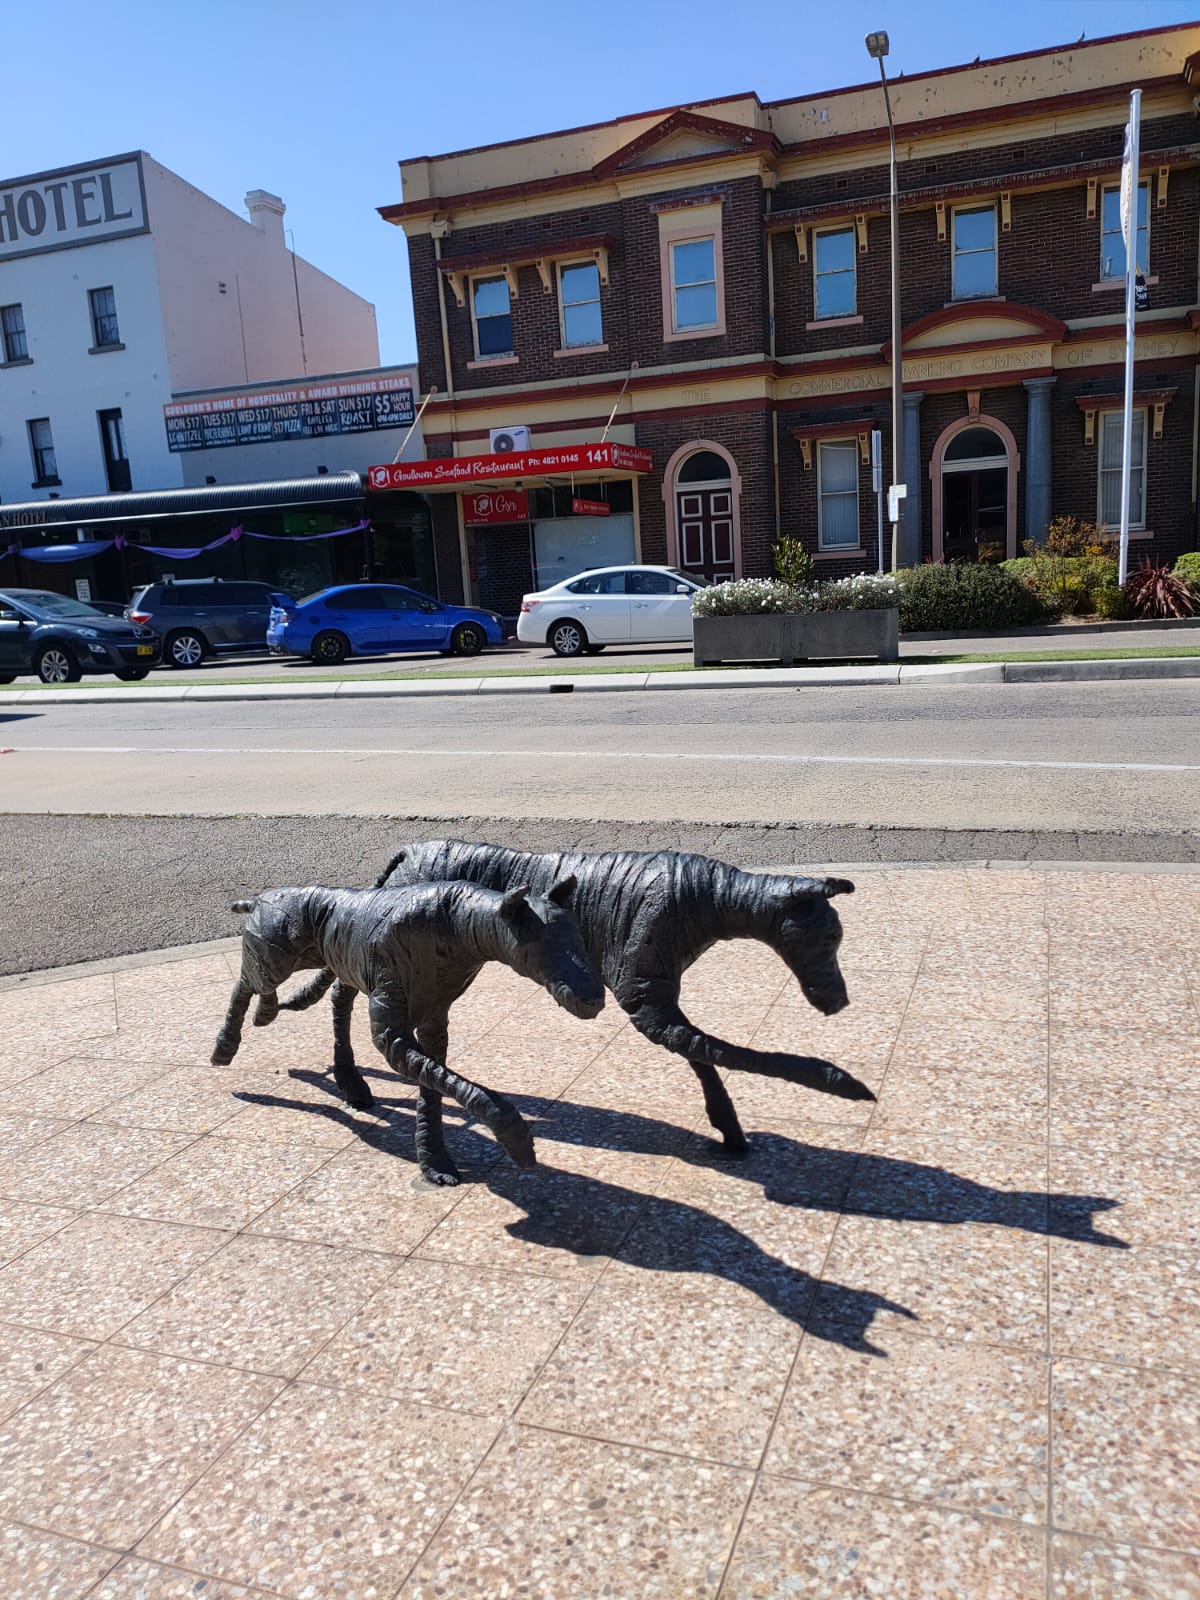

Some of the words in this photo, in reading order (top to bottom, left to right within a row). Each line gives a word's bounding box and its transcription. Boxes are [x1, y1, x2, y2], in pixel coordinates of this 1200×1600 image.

[0, 172, 133, 243] HOTEL
[683, 388, 713, 403] THE
[789, 373, 885, 396] COMMERCIAL
[902, 359, 963, 379] BANKING
[972, 349, 1046, 370] COMPANY
[1067, 349, 1093, 365] OF
[213, 399, 234, 410] HOME
[237, 398, 246, 407] OF
[248, 391, 296, 406] HOSPITALITY
[308, 387, 337, 399] AWARD
[339, 383, 377, 395] WINNING
[379, 377, 410, 390] STEAKS
[390, 391, 411, 402] HAPPY
[272, 404, 298, 418] THURS
[301, 403, 313, 416] FRI
[314, 404, 321, 415] &
[321, 401, 336, 414] SAT
[338, 398, 355, 412] SUN
[356, 395, 372, 409] $17
[375, 394, 391, 414] $5
[393, 401, 412, 412] HOUR
[203, 414, 221, 427] TUES
[222, 412, 236, 426] $17
[237, 410, 255, 423] WED
[256, 408, 270, 421] $17
[341, 410, 372, 425] ROAST
[168, 418, 186, 431] MON
[186, 416, 200, 429] $17
[274, 421, 284, 434] $17
[284, 418, 301, 433] PIZZA
[393, 468, 433, 482] Goulburn
[434, 463, 471, 479] Seafood
[473, 458, 525, 474] Restaurant
[528, 457, 541, 467] Ph:
[542, 455, 559, 465] 4821
[560, 453, 579, 464] 0145
[586, 448, 608, 463] 141
